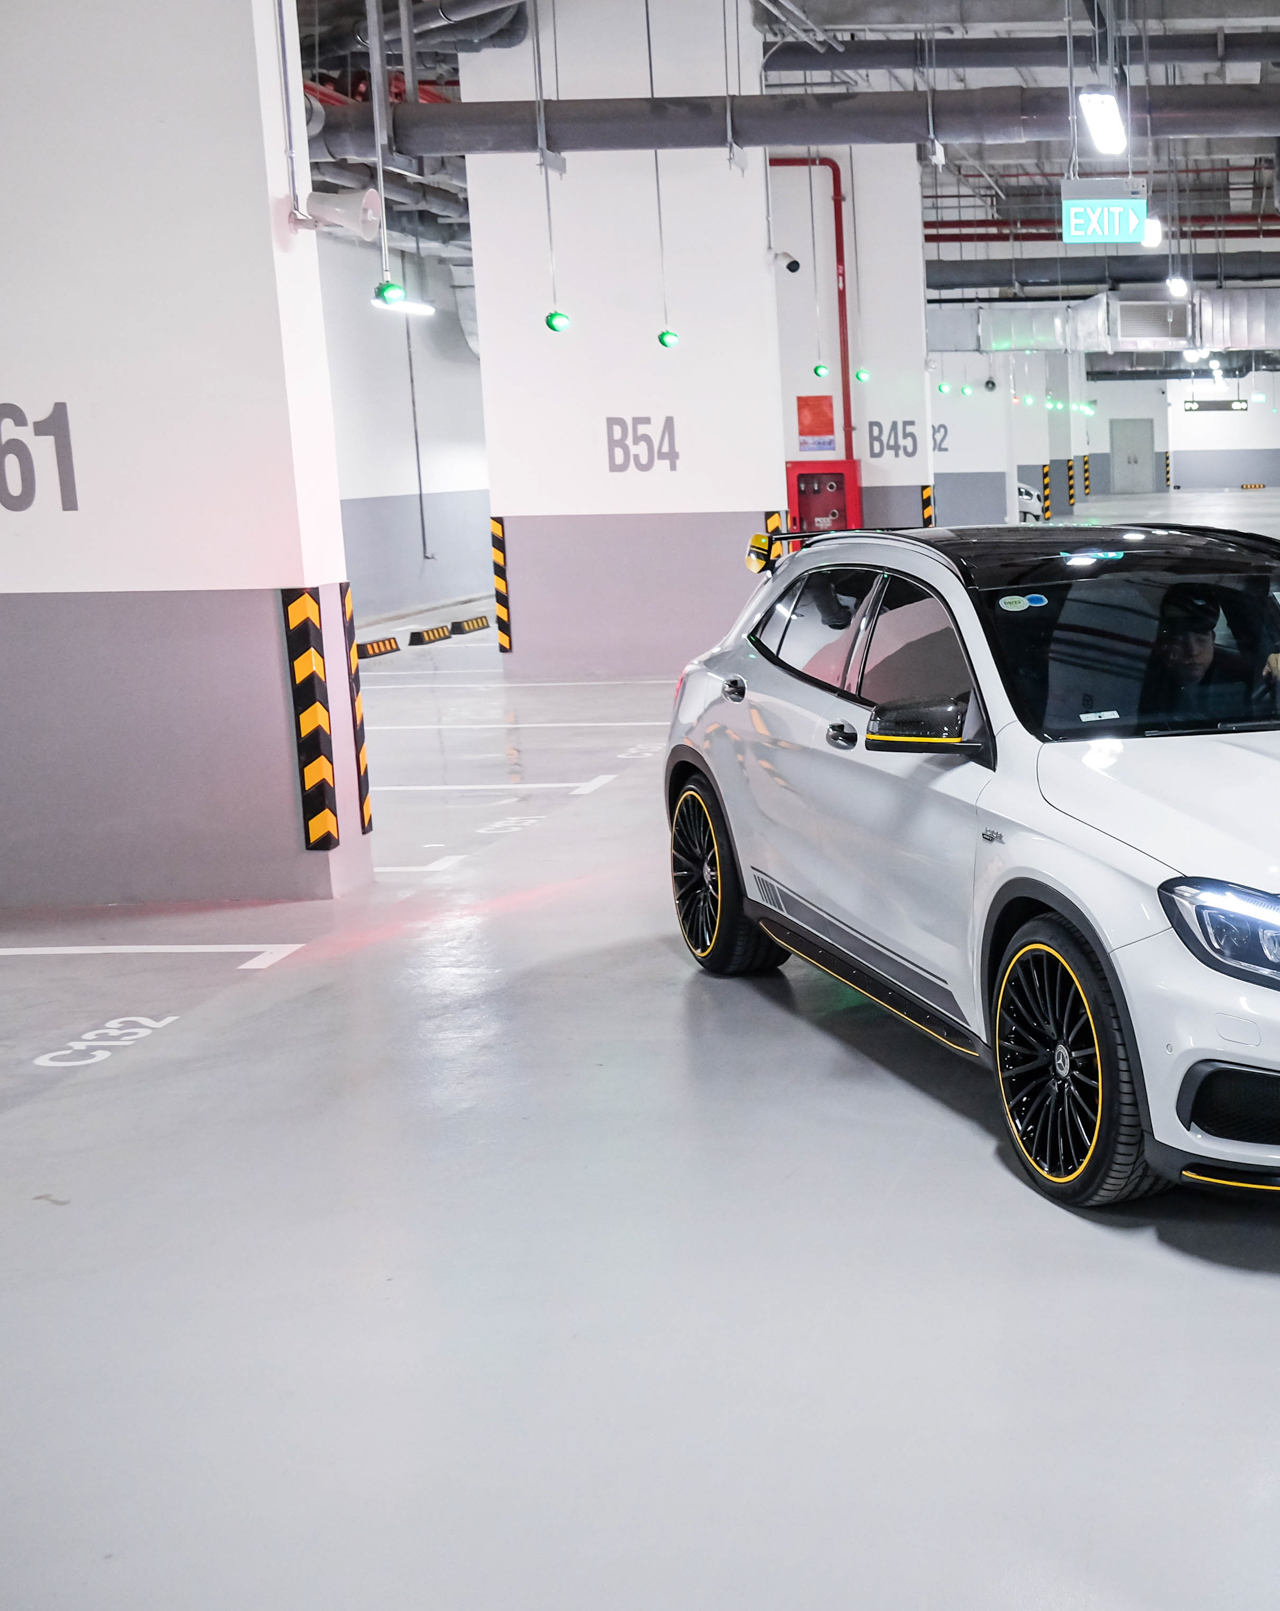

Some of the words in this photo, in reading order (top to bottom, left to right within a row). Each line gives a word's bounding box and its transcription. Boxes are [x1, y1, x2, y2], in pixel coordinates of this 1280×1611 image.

[1070, 206, 1125, 236] EXIT
[605, 415, 680, 473] B54
[868, 420, 918, 459] B45
[33, 1015, 180, 1067] C132
